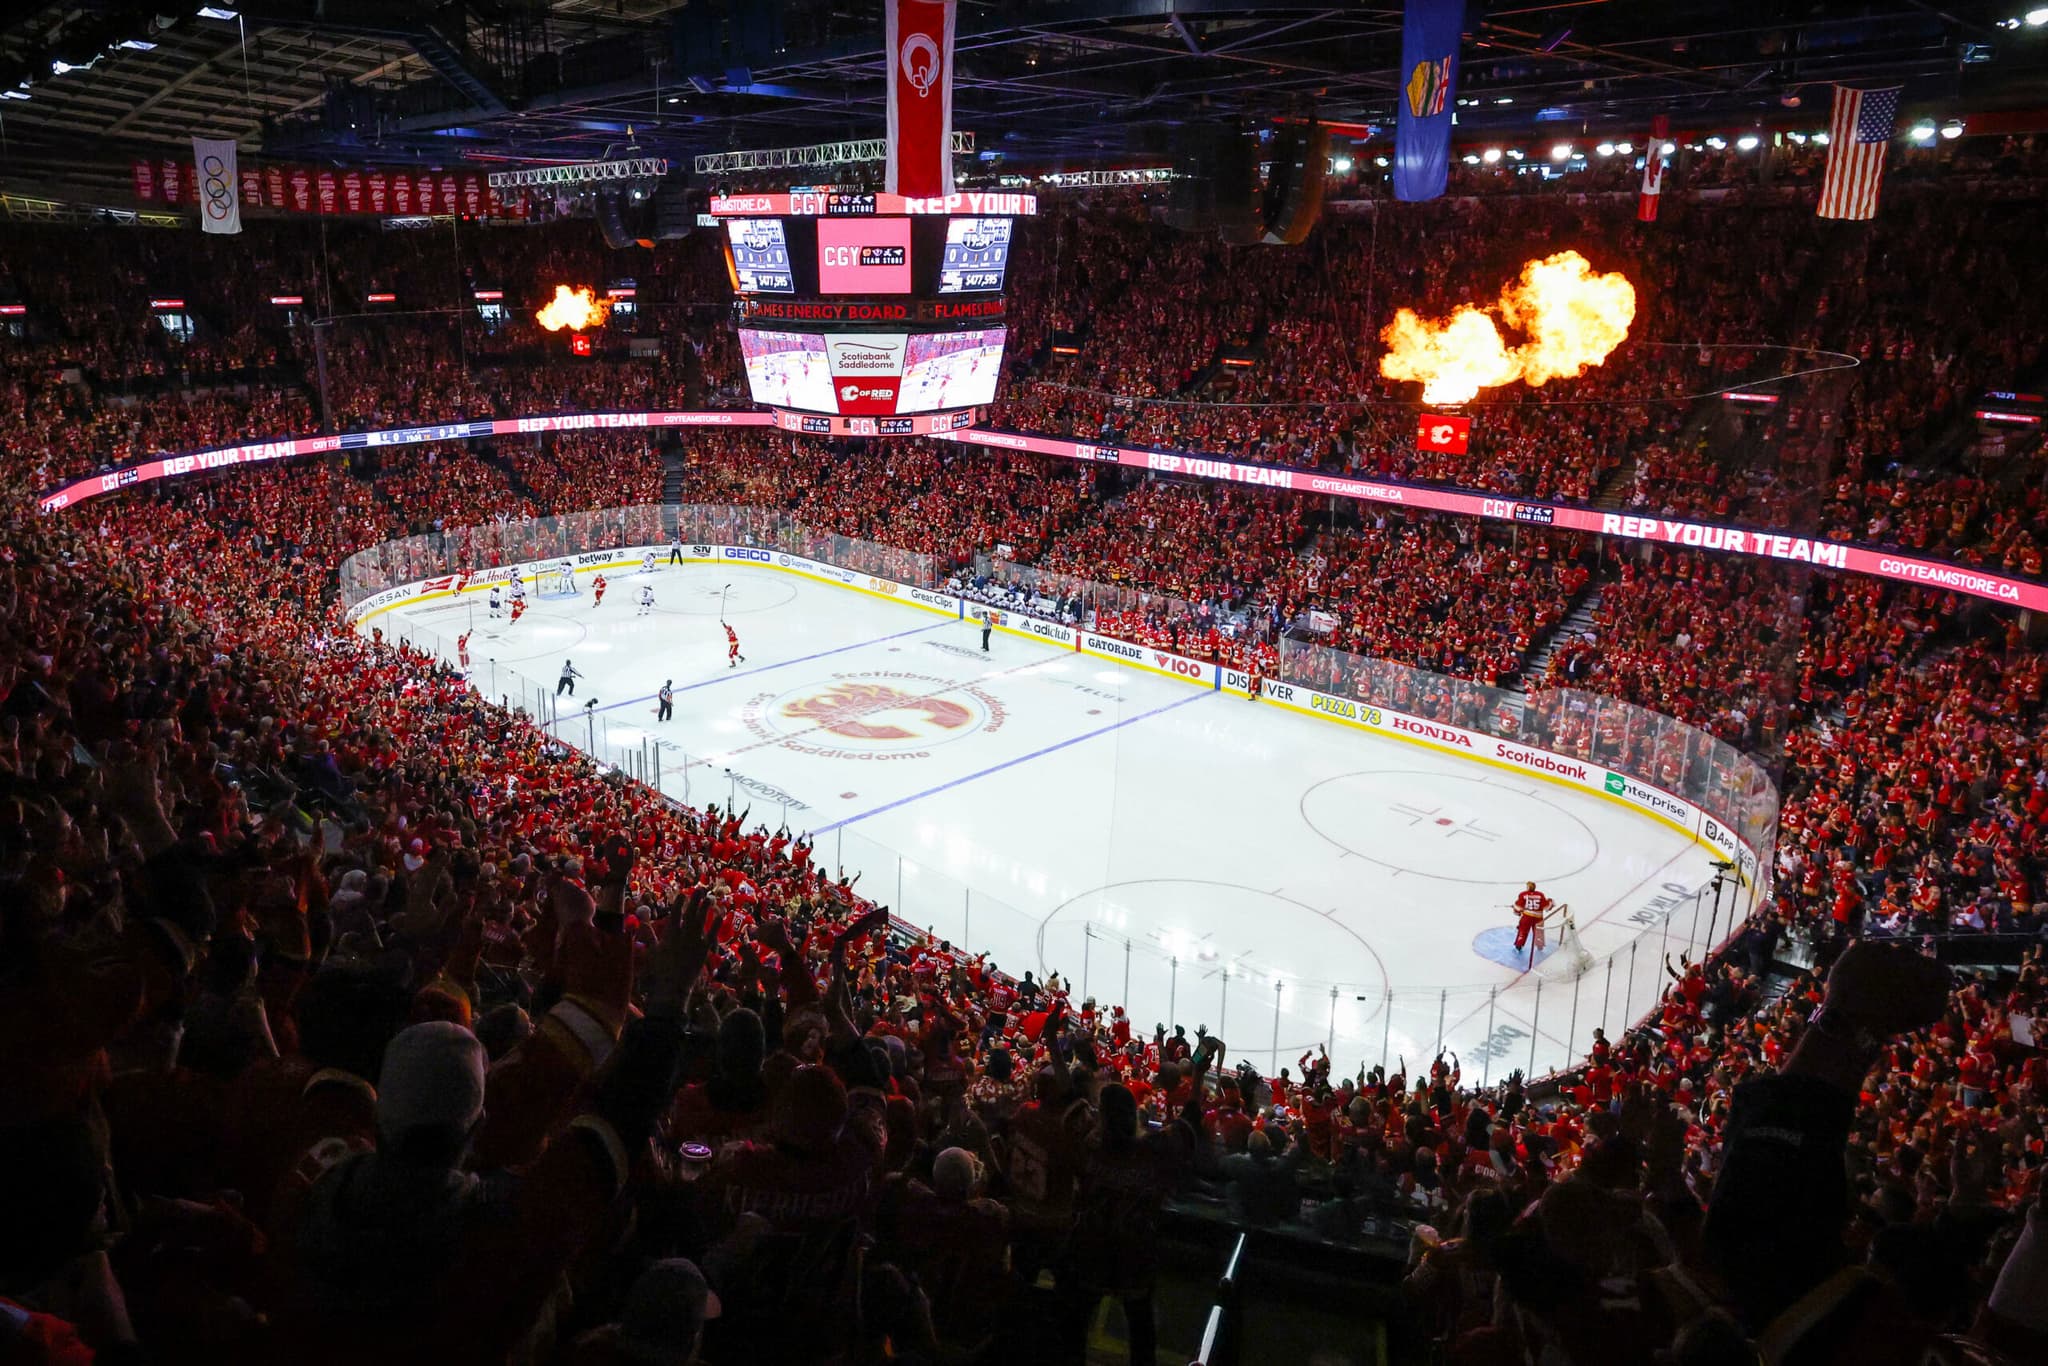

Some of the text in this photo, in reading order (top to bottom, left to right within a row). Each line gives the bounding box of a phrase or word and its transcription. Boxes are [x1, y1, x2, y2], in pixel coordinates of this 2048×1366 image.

[790, 193, 827, 215] CGY
[829, 205, 874, 213] TEAM STORE
[905, 194, 961, 214] REP
[967, 193, 1020, 215] YOUR
[824, 246, 859, 266] CGY
[786, 304, 843, 319] ENERGY
[848, 305, 906, 319] BOARD
[935, 302, 982, 319] FLAMES
[838, 360, 895, 369] Saddledome
[841, 352, 891, 361] Scotiabank
[871, 389, 893, 397] RED
[518, 413, 648, 433] REP YOUR TEAM!
[785, 414, 801, 430] CGY
[932, 415, 952, 432] CGY
[163, 440, 296, 477] REP YOUR TEAM!
[1076, 445, 1096, 459] CGY
[1148, 453, 1292, 488] REP YOUR TEAM!
[102, 471, 119, 491] CGY
[1312, 478, 1402, 500] CGYTEAMSTORE.CA
[1483, 500, 1514, 519] CGY
[1515, 512, 1551, 522] TEAM STORE
[693, 545, 711, 553] SN
[1602, 513, 1847, 569] REP YOUR TEAM!
[579, 552, 613, 565] betway
[725, 547, 771, 562] GEICO
[878, 579, 898, 595] SKIP
[1880, 558, 2019, 600] CGYTEAMSTORE.CA
[368, 587, 411, 608] NISSAN
[911, 588, 953, 608] Great Clips
[1034, 624, 1070, 641] adiclub
[1088, 637, 1143, 660] GATORADE
[831, 670, 956, 686] Scotiabank
[1171, 658, 1201, 678] 100
[1311, 694, 1382, 725] PIZZA 73
[1392, 717, 1472, 748] HONDA
[780, 739, 932, 761] Saddledome
[1496, 743, 1587, 781] Scotiabank
[724, 771, 812, 811] JACKPOTCITY
[1605, 776, 1687, 819] enterprise
